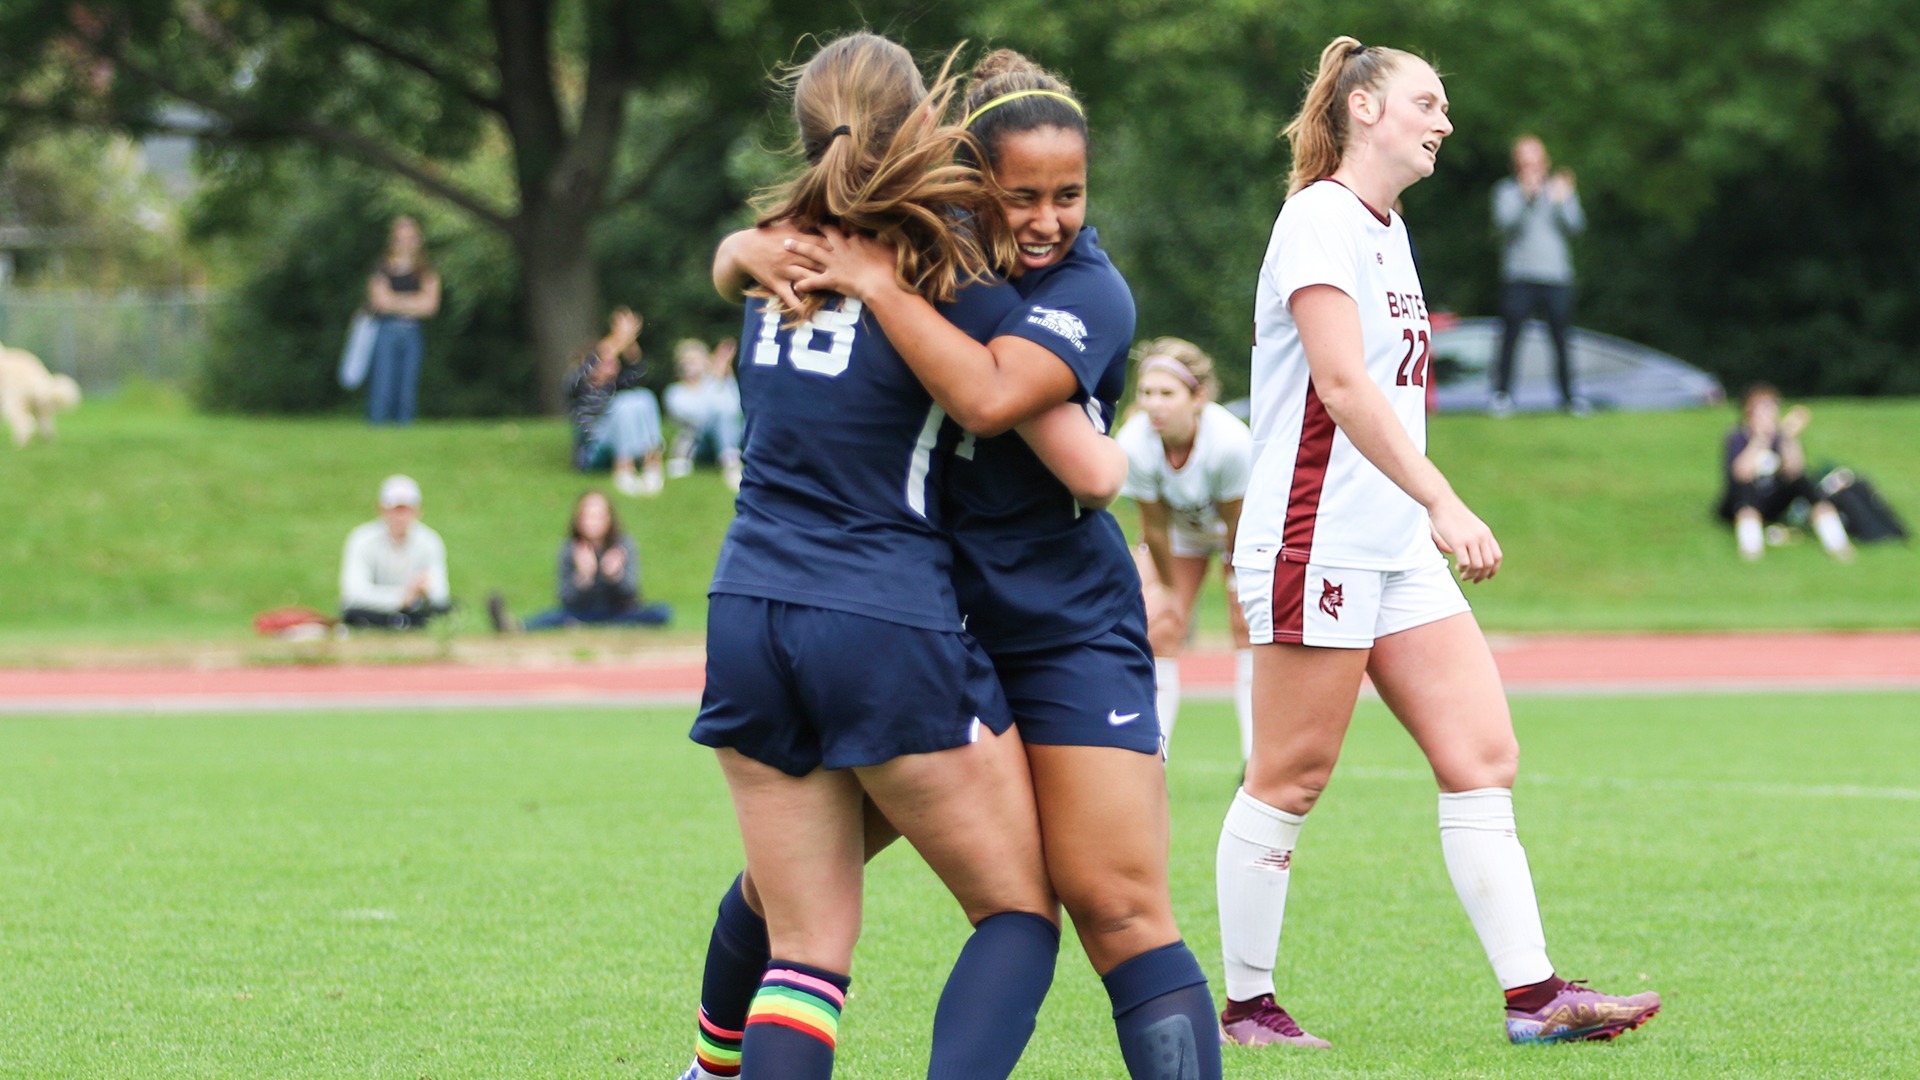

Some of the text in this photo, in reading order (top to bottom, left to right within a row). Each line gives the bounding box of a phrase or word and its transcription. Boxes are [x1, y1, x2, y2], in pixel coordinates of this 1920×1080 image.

[1386, 291, 1426, 320] BATE
[755, 296, 862, 376] 18
[1027, 315, 1086, 352] MIDDLEBURY
[1396, 328, 1430, 388] 22
